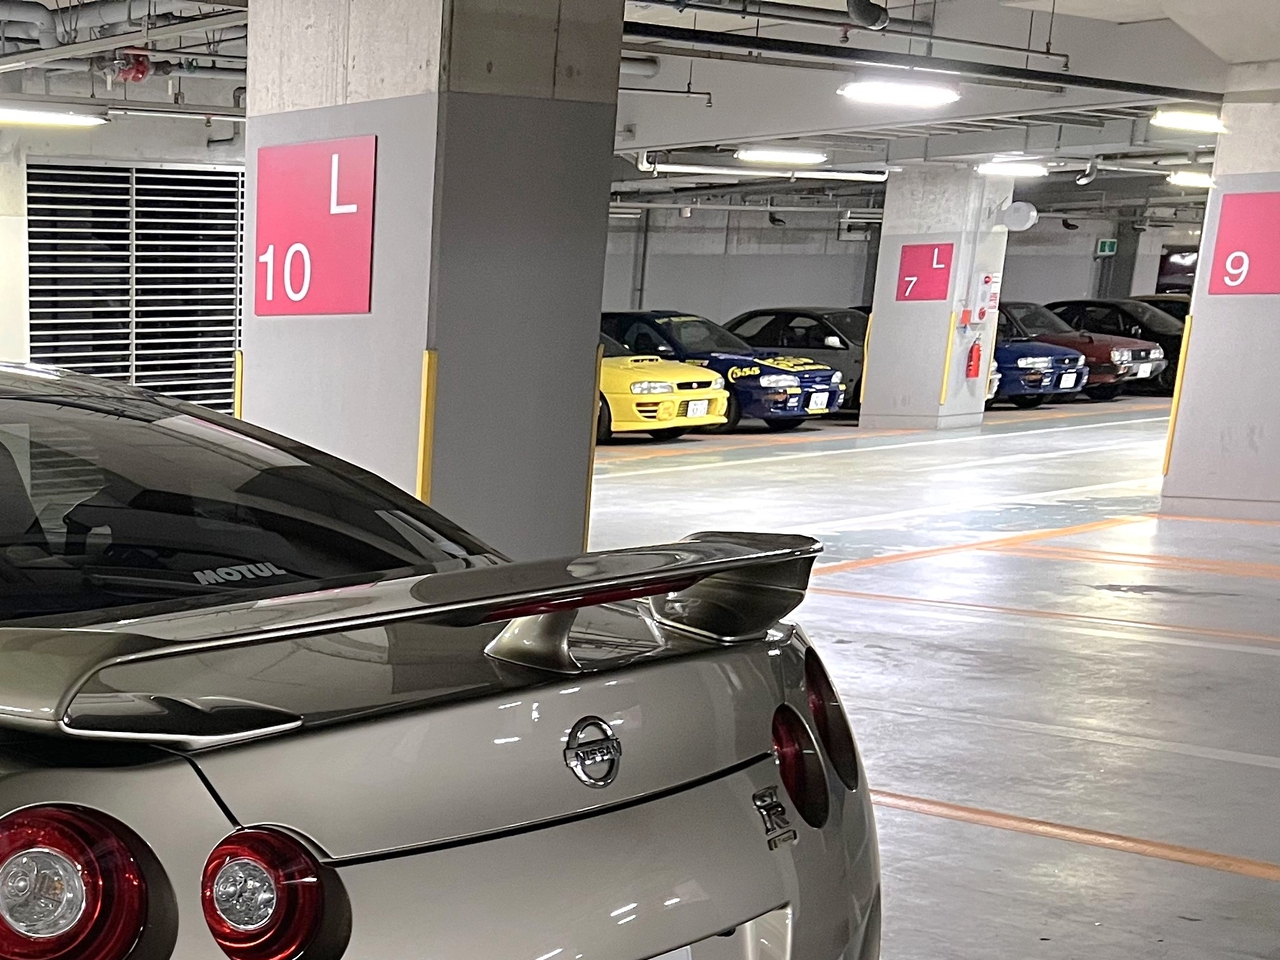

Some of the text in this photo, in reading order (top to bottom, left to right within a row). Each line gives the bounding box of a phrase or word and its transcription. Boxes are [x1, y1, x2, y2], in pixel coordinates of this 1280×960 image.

[330, 153, 358, 215] L
[932, 247, 946, 269] L
[1223, 250, 1250, 287] 9
[258, 242, 312, 302] 10
[904, 276, 918, 297] 7
[193, 562, 288, 586] MOTUL
[575, 741, 621, 764] NISSAN
